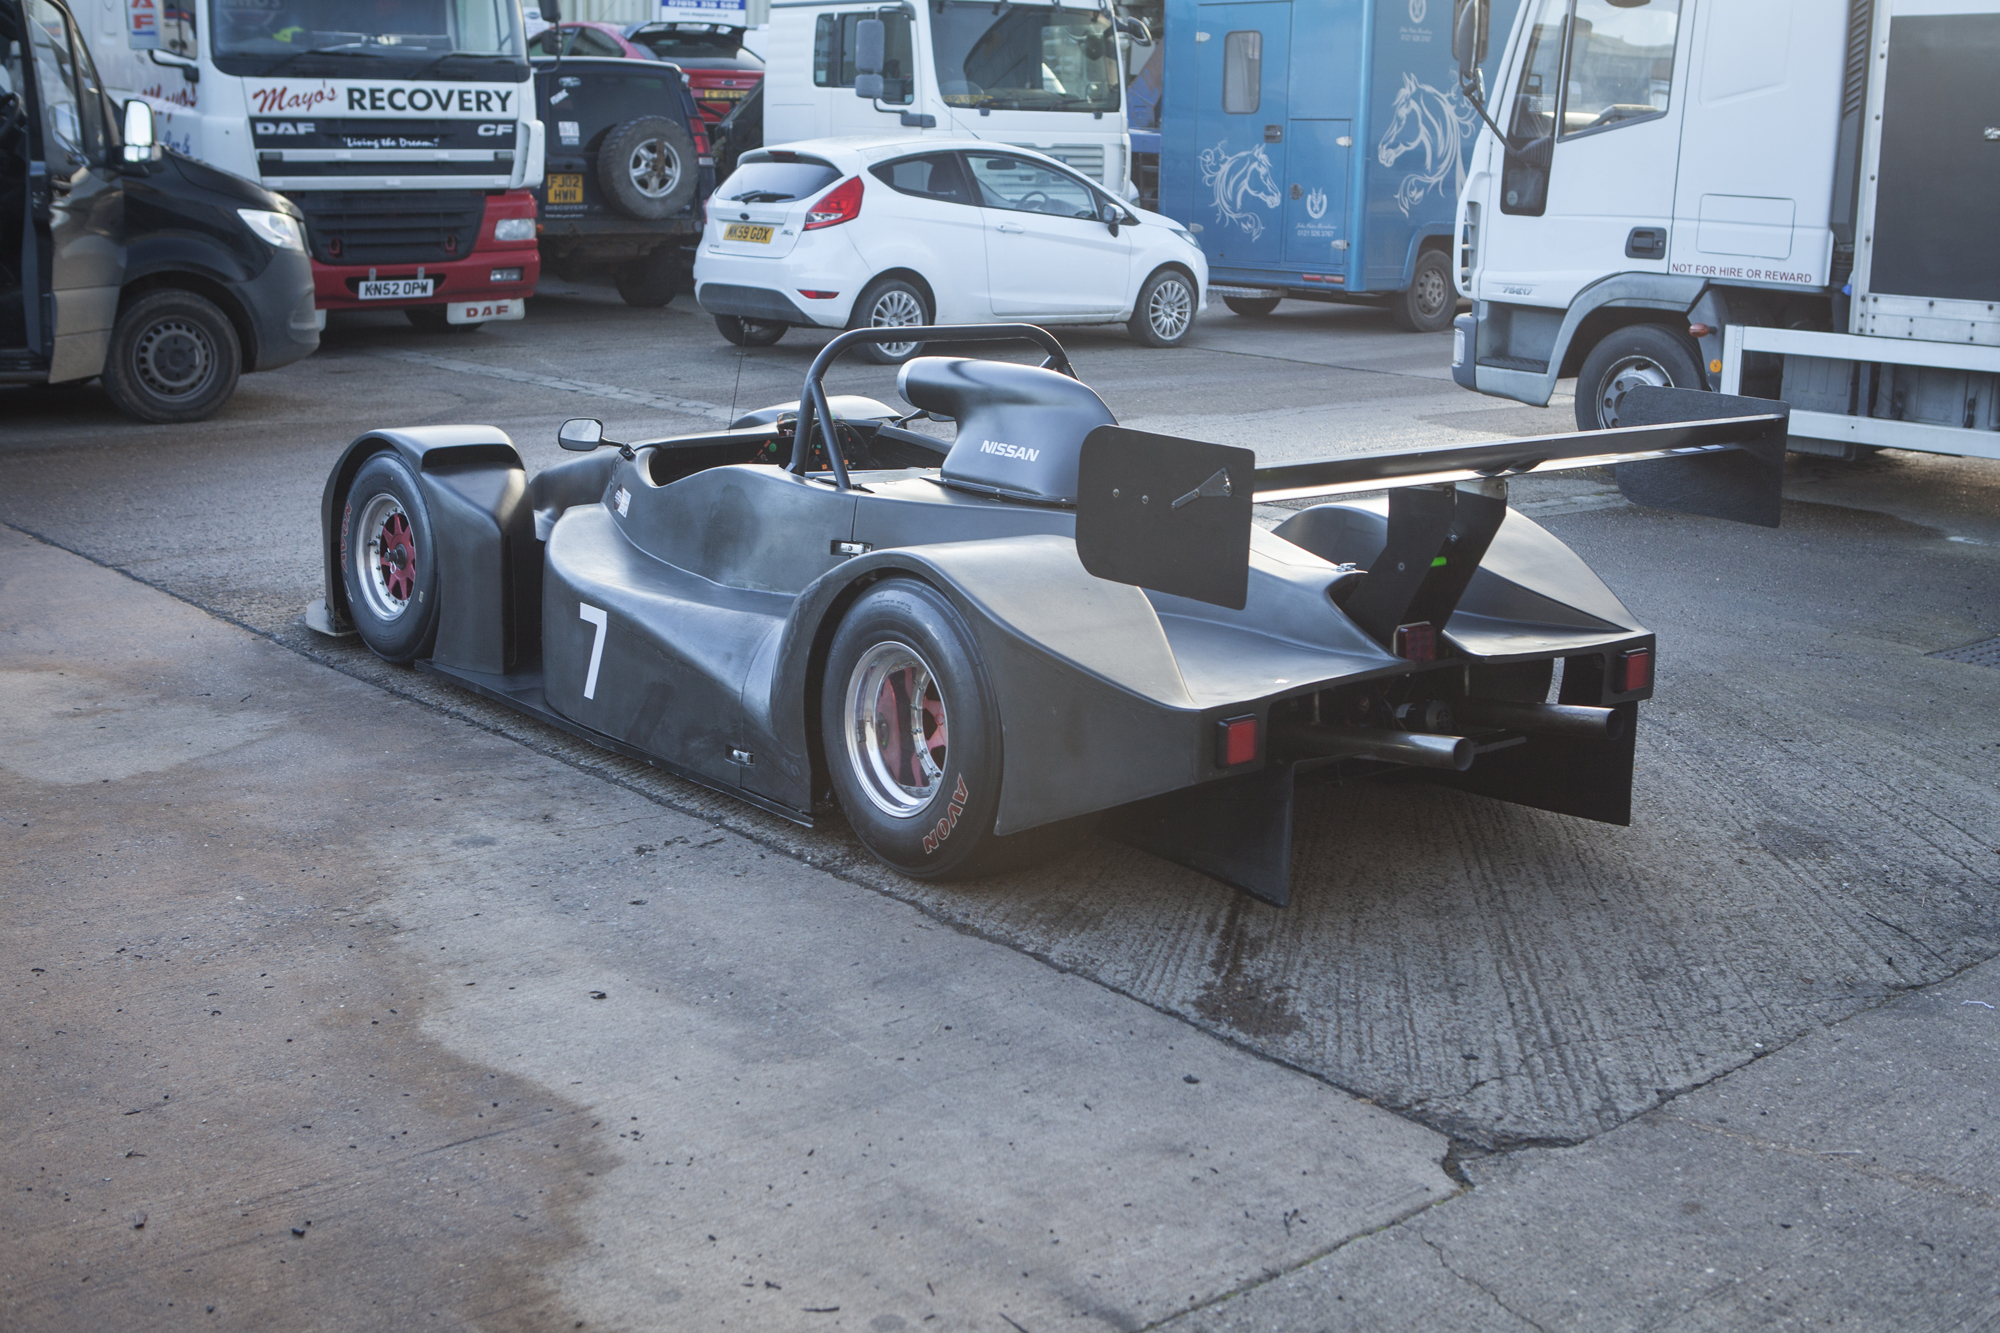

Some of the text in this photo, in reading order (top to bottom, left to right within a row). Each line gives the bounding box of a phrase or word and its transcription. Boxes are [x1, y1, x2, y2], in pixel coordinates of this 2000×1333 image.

[253, 79, 513, 113] Mayo's RECOVERY
[255, 122, 514, 136] DAF CF
[549, 175, 580, 190] FJ02
[554, 189, 577, 201] HWN
[1671, 262, 1812, 283] NOT FOR HIRE OR REWARD
[364, 280, 429, 297] KN52 OPW
[465, 304, 509, 318] DAF
[980, 439, 1040, 462] NISSAN
[341, 499, 353, 575] AVON
[580, 602, 607, 700] 7
[922, 772, 969, 855] AVON
